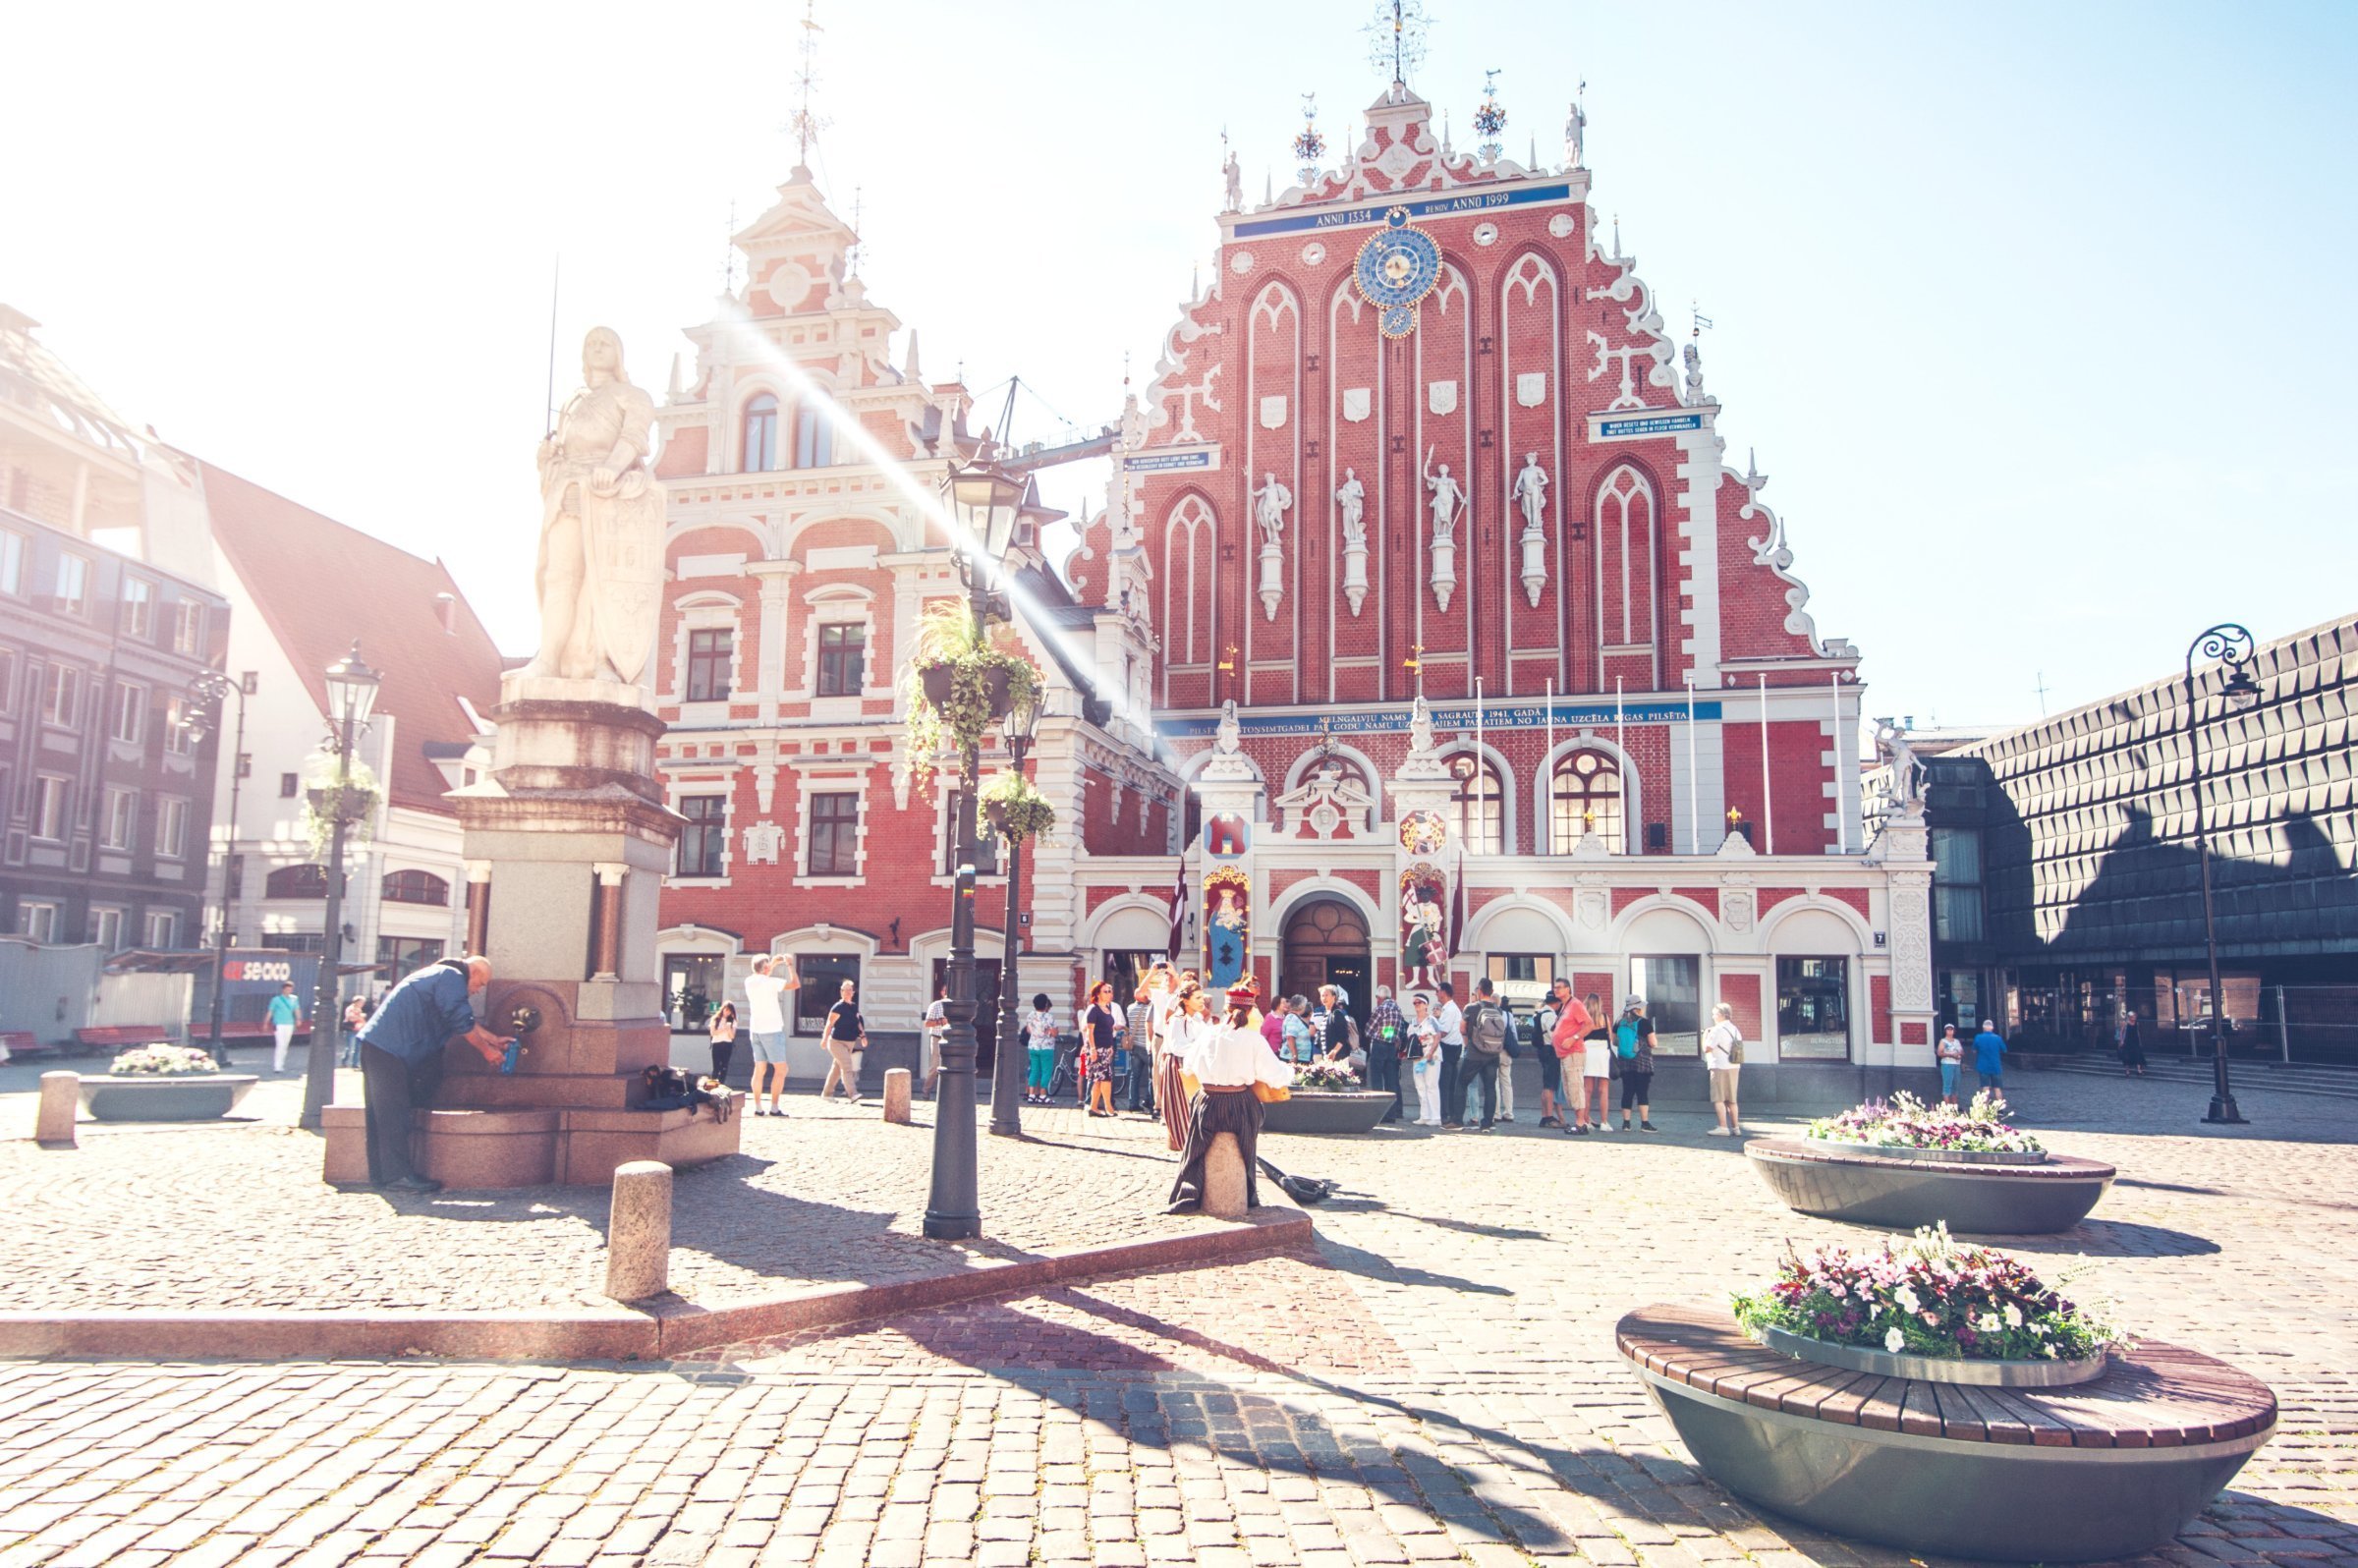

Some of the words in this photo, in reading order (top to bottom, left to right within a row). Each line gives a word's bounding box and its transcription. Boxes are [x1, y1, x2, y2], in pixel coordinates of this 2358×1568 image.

[1452, 195, 1482, 211] ANNO
[1486, 193, 1509, 206] 1999
[1317, 211, 1344, 227] ANNO
[1348, 209, 1372, 223] 1334
[1381, 713, 1407, 722] NAMS
[1489, 709, 1510, 718] 1941.
[1514, 707, 1544, 717] GADĀ.
[1517, 716, 1532, 725] NO
[1537, 715, 1567, 724] JANA
[1571, 713, 1609, 723] UZCĒLA
[243, 961, 291, 981] seaco
